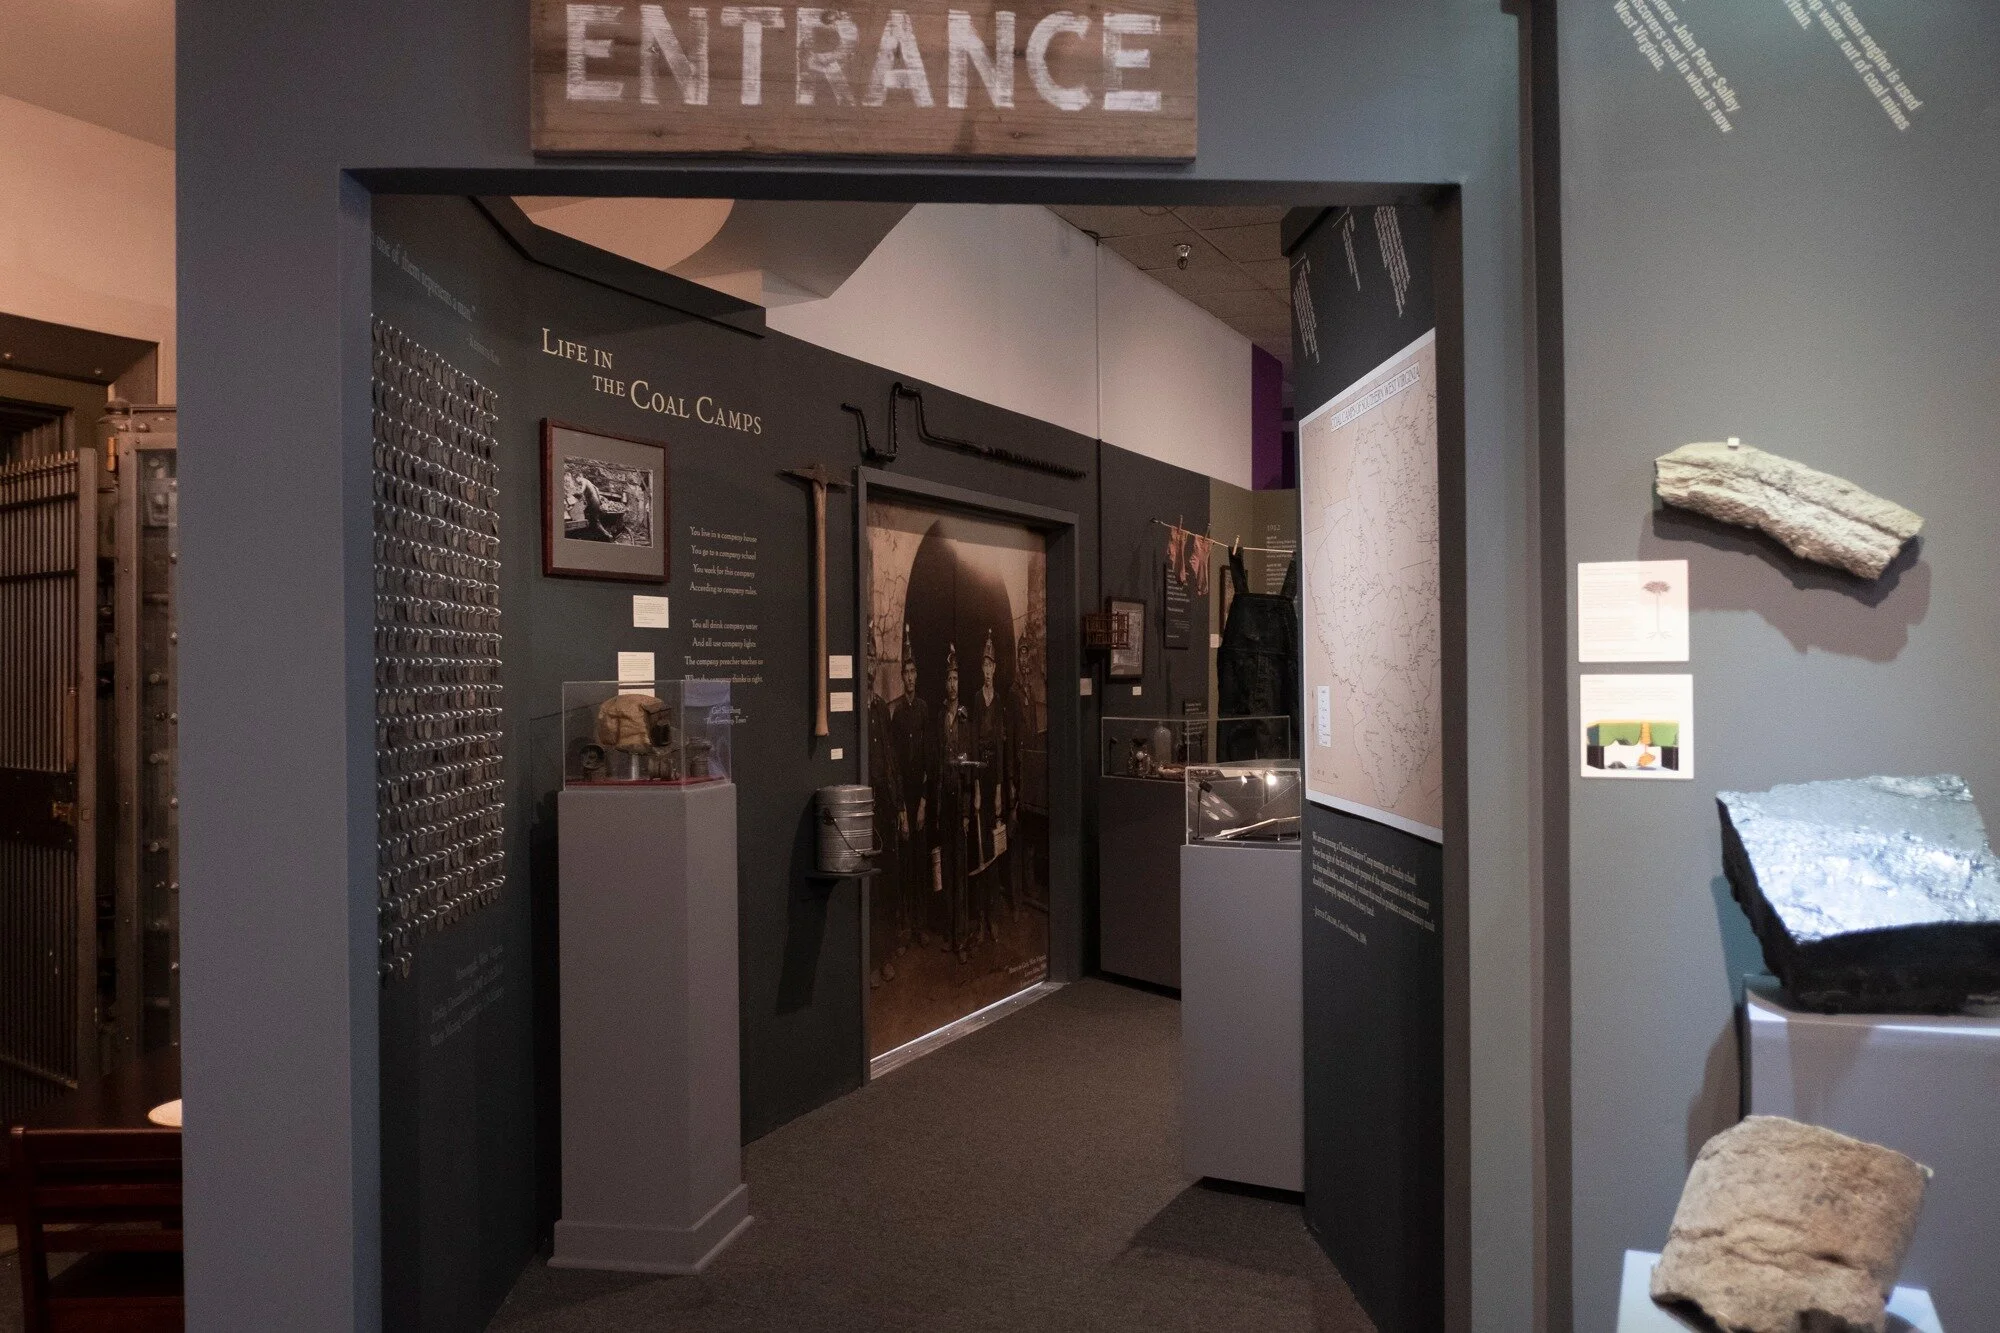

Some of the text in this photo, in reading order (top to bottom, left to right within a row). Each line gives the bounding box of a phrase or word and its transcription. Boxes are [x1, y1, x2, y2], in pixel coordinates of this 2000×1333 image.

[565, 3, 1163, 111] ENTRANCE
[1613, 0, 1664, 72] West Virginia.
[1836, 1, 1924, 111] steam engine is used
[1661, 38, 1685, 62] coal
[1676, 58, 1690, 74] in
[1685, 71, 1710, 100] what
[1703, 96, 1716, 111] is
[1710, 109, 1733, 133] now
[1672, 24, 1698, 52] John
[1691, 47, 1718, 79] Peter
[1712, 77, 1741, 112] Salley
[1819, 9, 1847, 40] water
[1840, 41, 1861, 61] out
[1854, 59, 1873, 73] of
[1864, 72, 1890, 98] coal
[1880, 95, 1910, 131] mines
[542, 327, 613, 370] LIFE IN
[592, 375, 762, 435] THE COAL CAMPS
[689, 526, 700, 536] You
[701, 527, 710, 537] live
[721, 533, 743, 542] company
[743, 533, 758, 542] house
[691, 545, 701, 554] You
[702, 549, 709, 557] go
[720, 551, 741, 560] company
[741, 550, 757, 560] school
[689, 582, 717, 595] According
[723, 587, 744, 596] company
[693, 563, 704, 573] You
[704, 565, 716, 574] work
[716, 566, 724, 576] for
[734, 571, 755, 579] company
[691, 619, 701, 628] You
[710, 620, 723, 629] drink
[724, 623, 745, 631] company
[692, 637, 705, 647] And
[722, 641, 743, 649] company
[684, 656, 695, 665] The
[696, 659, 719, 667] company
